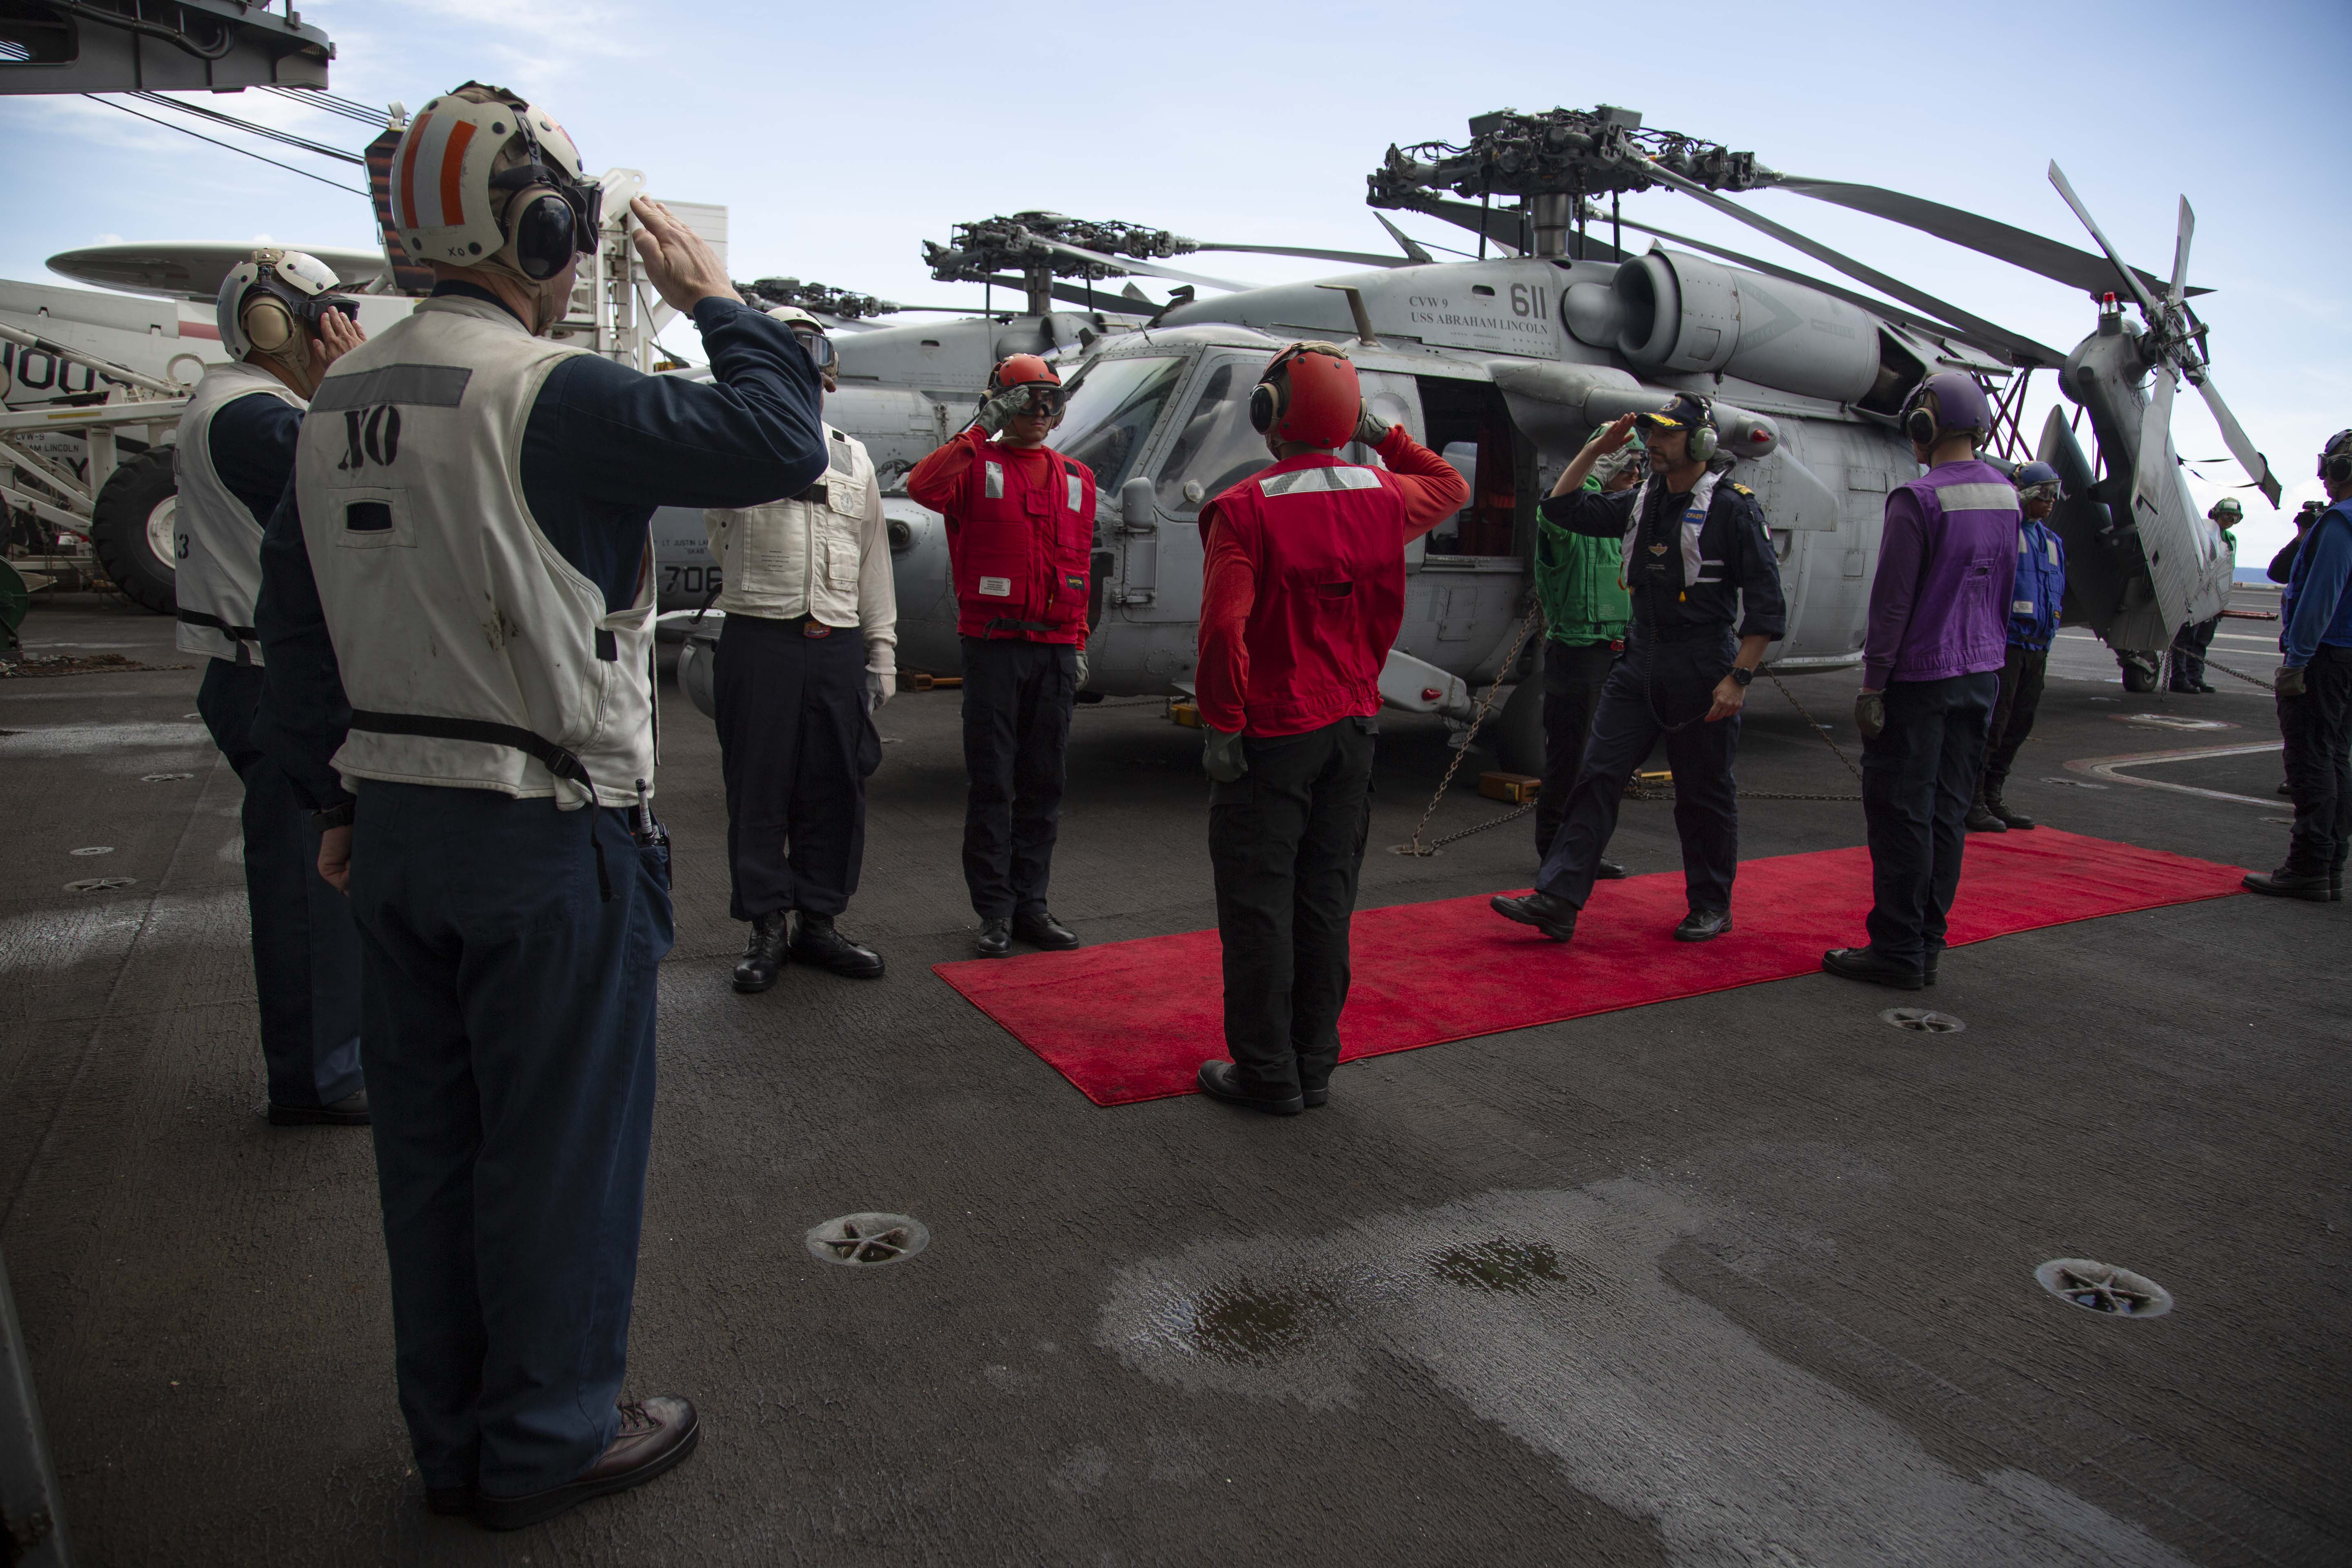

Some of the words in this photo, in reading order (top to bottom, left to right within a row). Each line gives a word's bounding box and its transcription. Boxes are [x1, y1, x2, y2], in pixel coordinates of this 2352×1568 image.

[1409, 296, 1440, 308] CVW
[1442, 299, 1448, 308] 9
[1510, 283, 1547, 320] 611
[1411, 312, 1434, 323] USS
[1437, 314, 1497, 328] ABRAHAM
[1500, 320, 1548, 335] LINCOLN
[45, 444, 79, 452] LINCOLN
